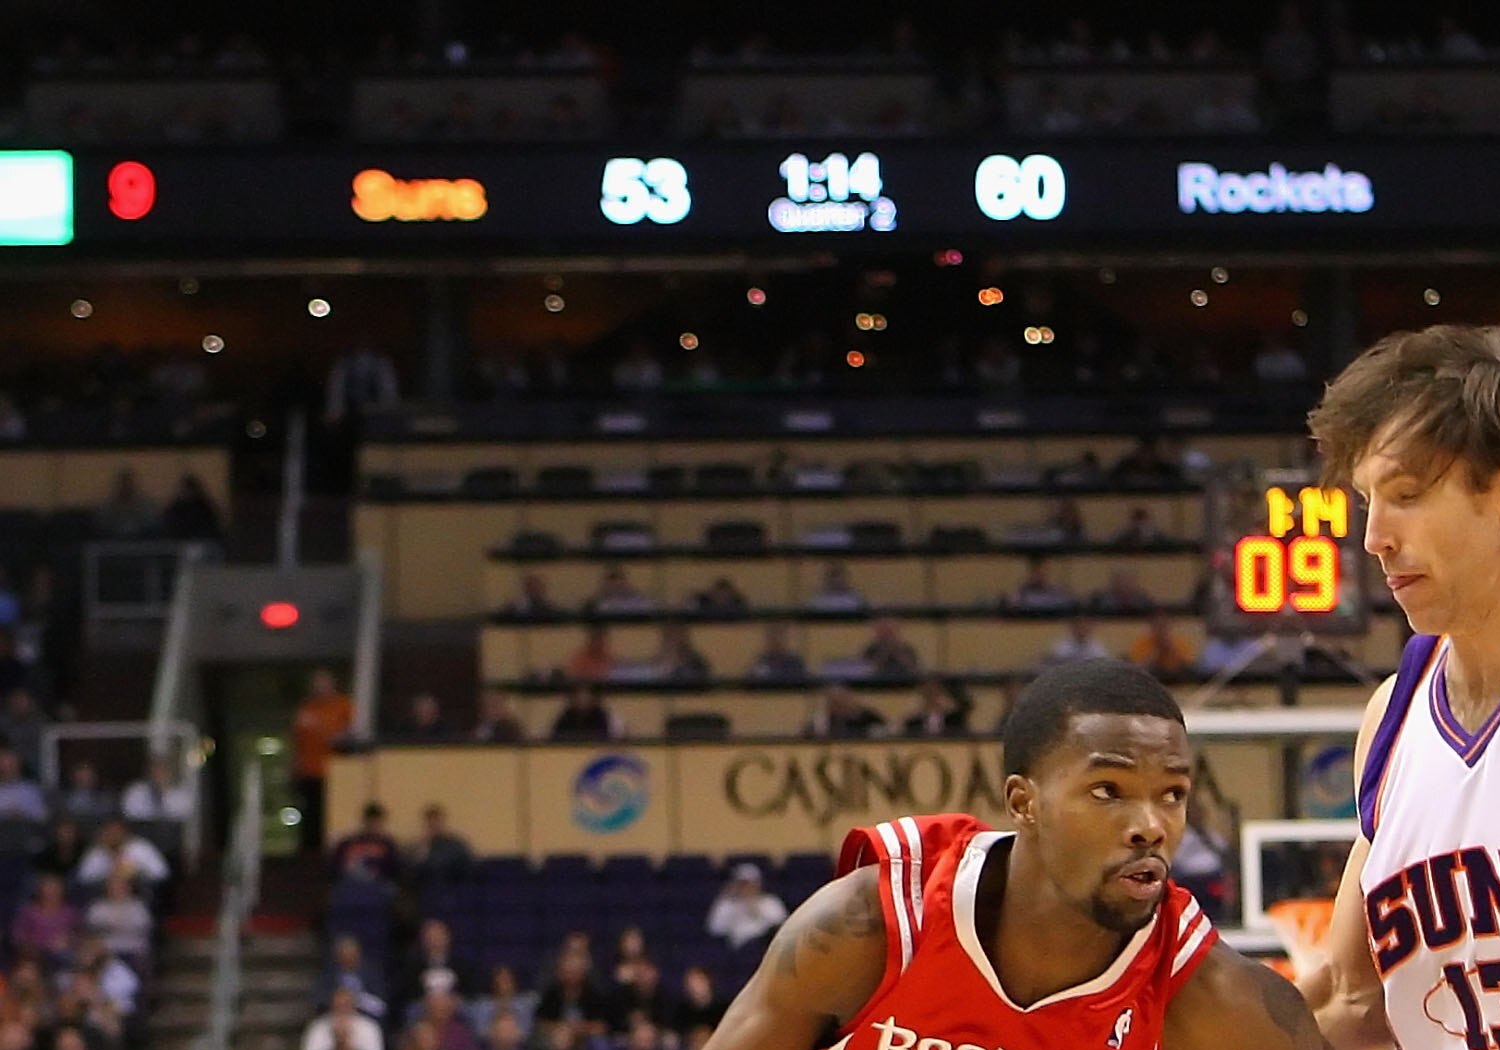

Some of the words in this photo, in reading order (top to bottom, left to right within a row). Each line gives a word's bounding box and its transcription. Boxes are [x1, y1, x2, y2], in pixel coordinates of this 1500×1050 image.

[107, 160, 156, 220] 9
[600, 157, 692, 225] 53
[778, 151, 884, 202] 1:14
[974, 154, 1067, 220] 60
[1177, 161, 1375, 214] Rockets
[1234, 535, 1342, 613] 09
[724, 751, 950, 826] CASINO
